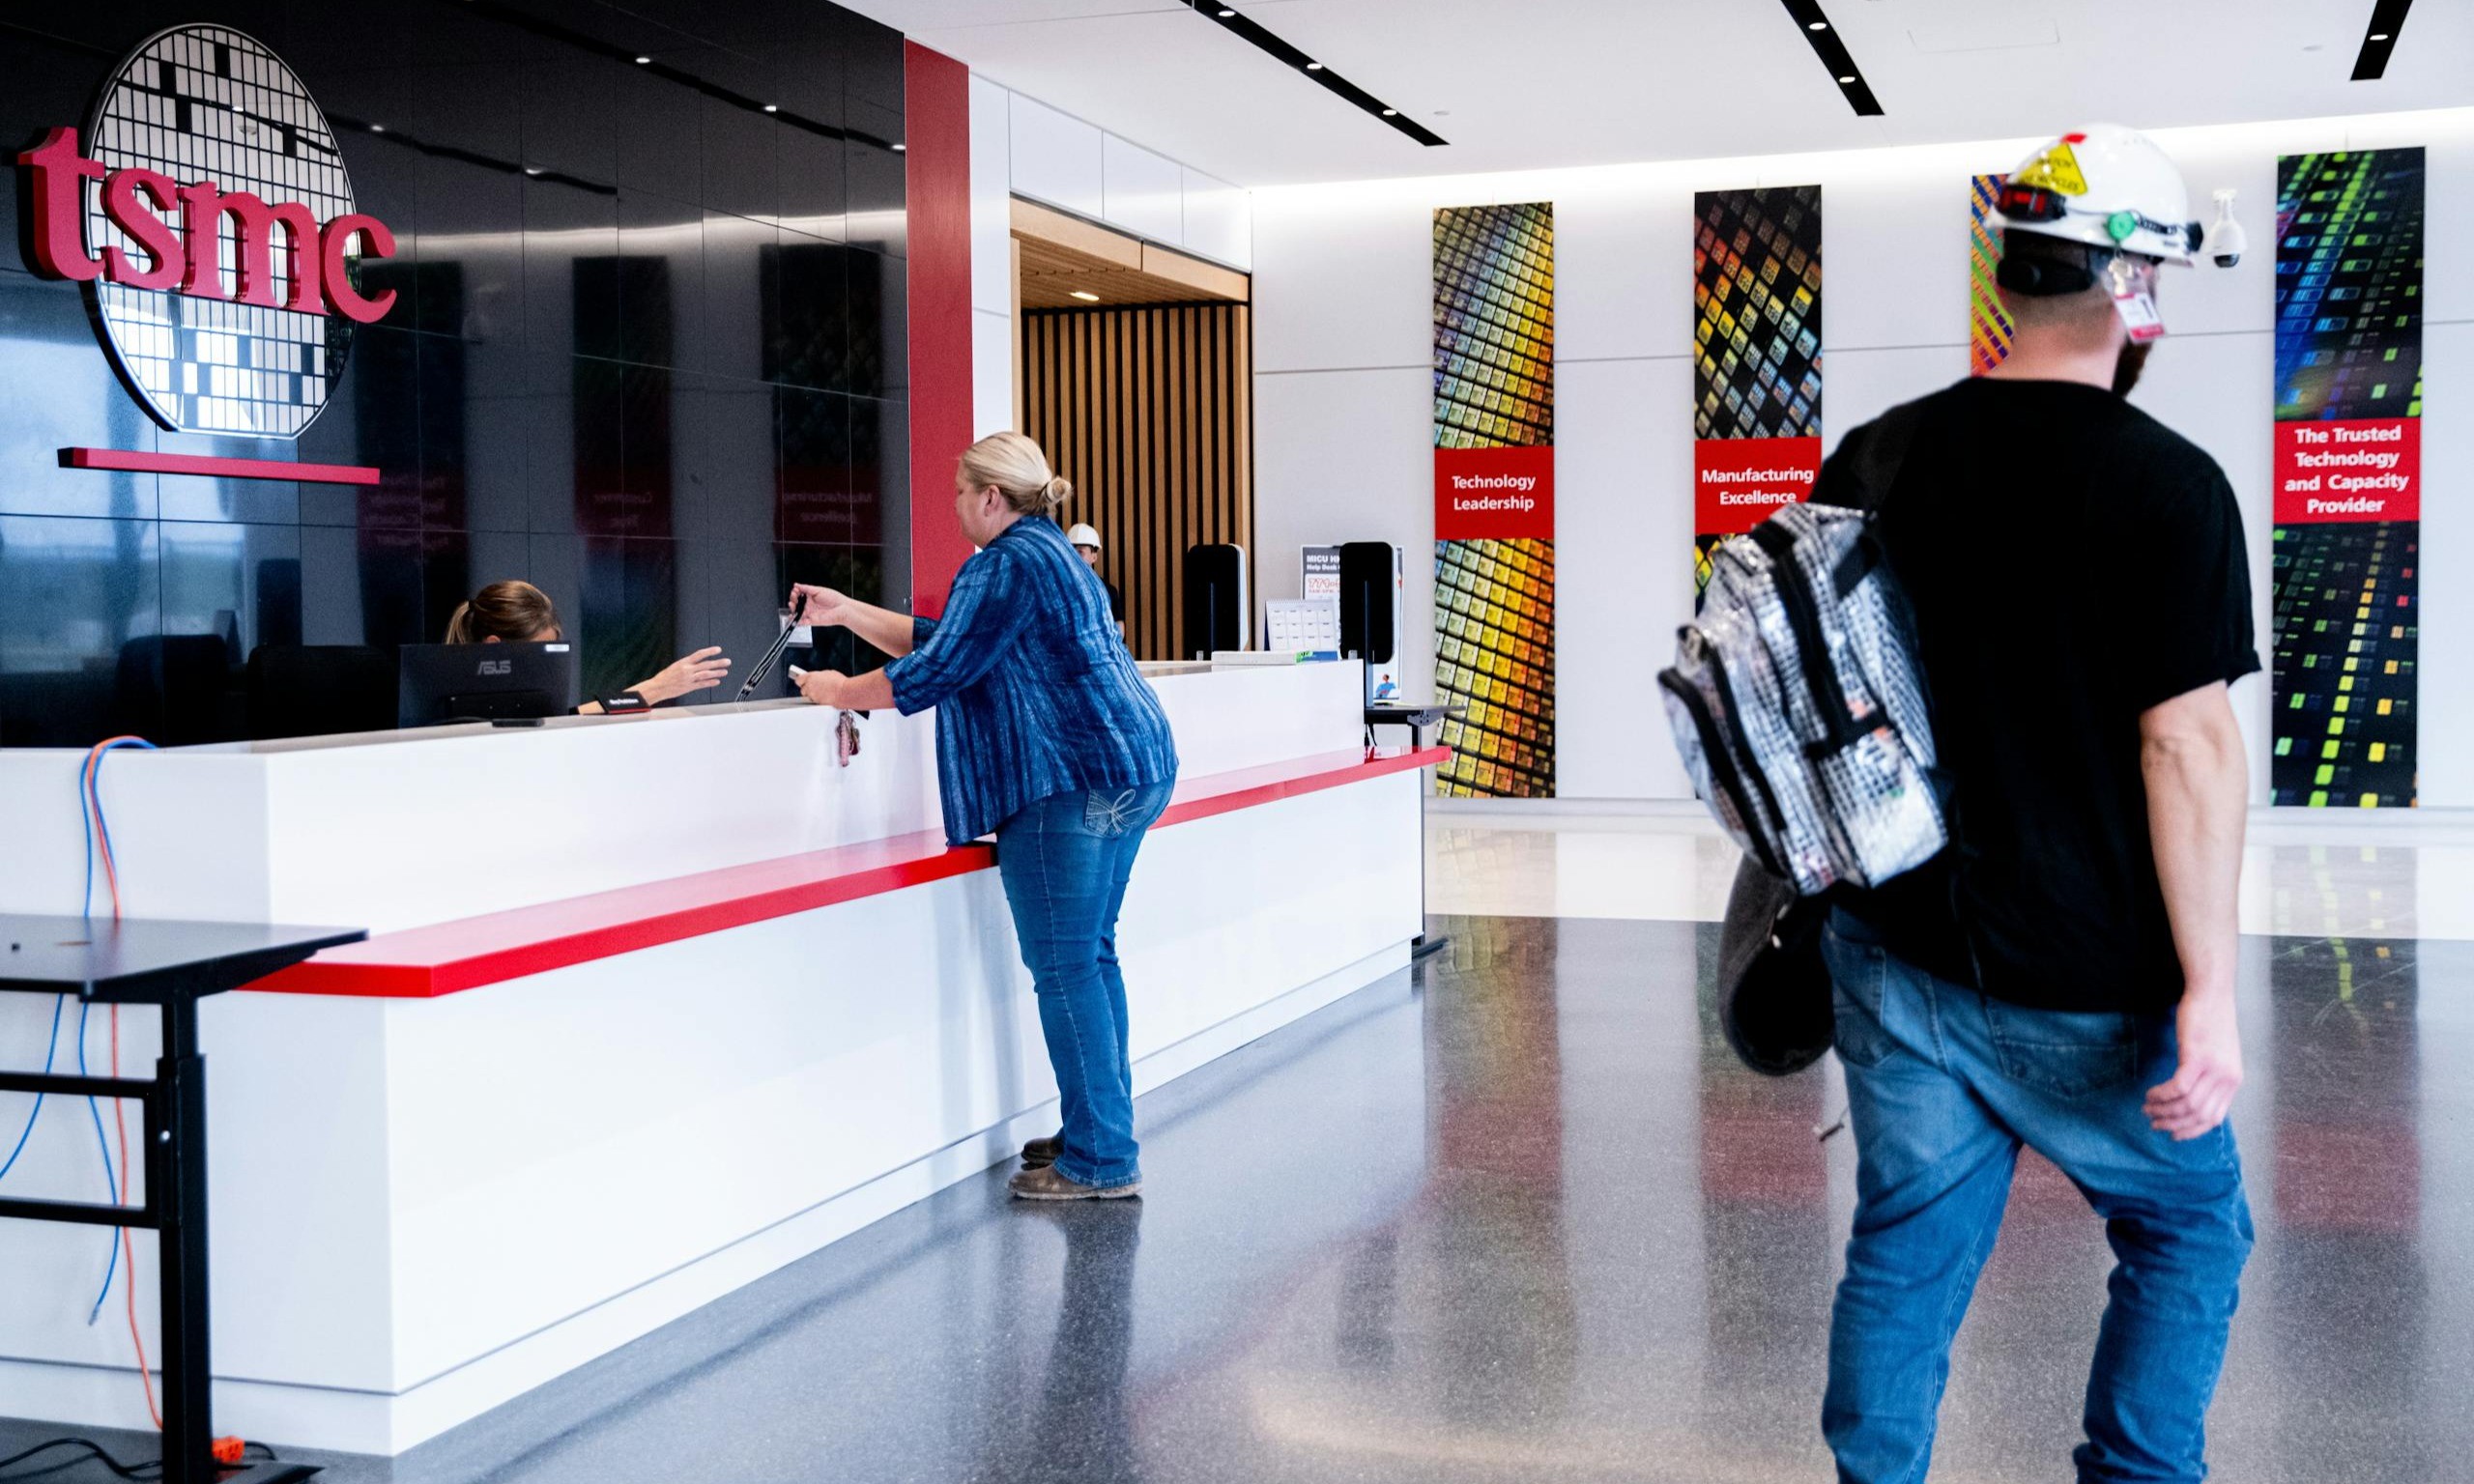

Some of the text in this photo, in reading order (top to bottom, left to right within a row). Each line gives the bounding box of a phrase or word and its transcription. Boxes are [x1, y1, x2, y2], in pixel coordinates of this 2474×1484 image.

[18, 127, 397, 324] tsmc
[2294, 424, 2402, 444] The Trusted
[2294, 449, 2401, 470] Technology
[1452, 473, 1537, 491] Technology
[1702, 467, 1815, 484] Manufacturing
[2284, 472, 2410, 493] and Capacity
[1453, 495, 1535, 512] Leadership
[1719, 489, 1798, 505] Excellence
[2306, 497, 2386, 514] Provider
[1306, 555, 1329, 563] MICU
[1306, 563, 1338, 573] Help Desk
[477, 660, 511, 674] ASUS
